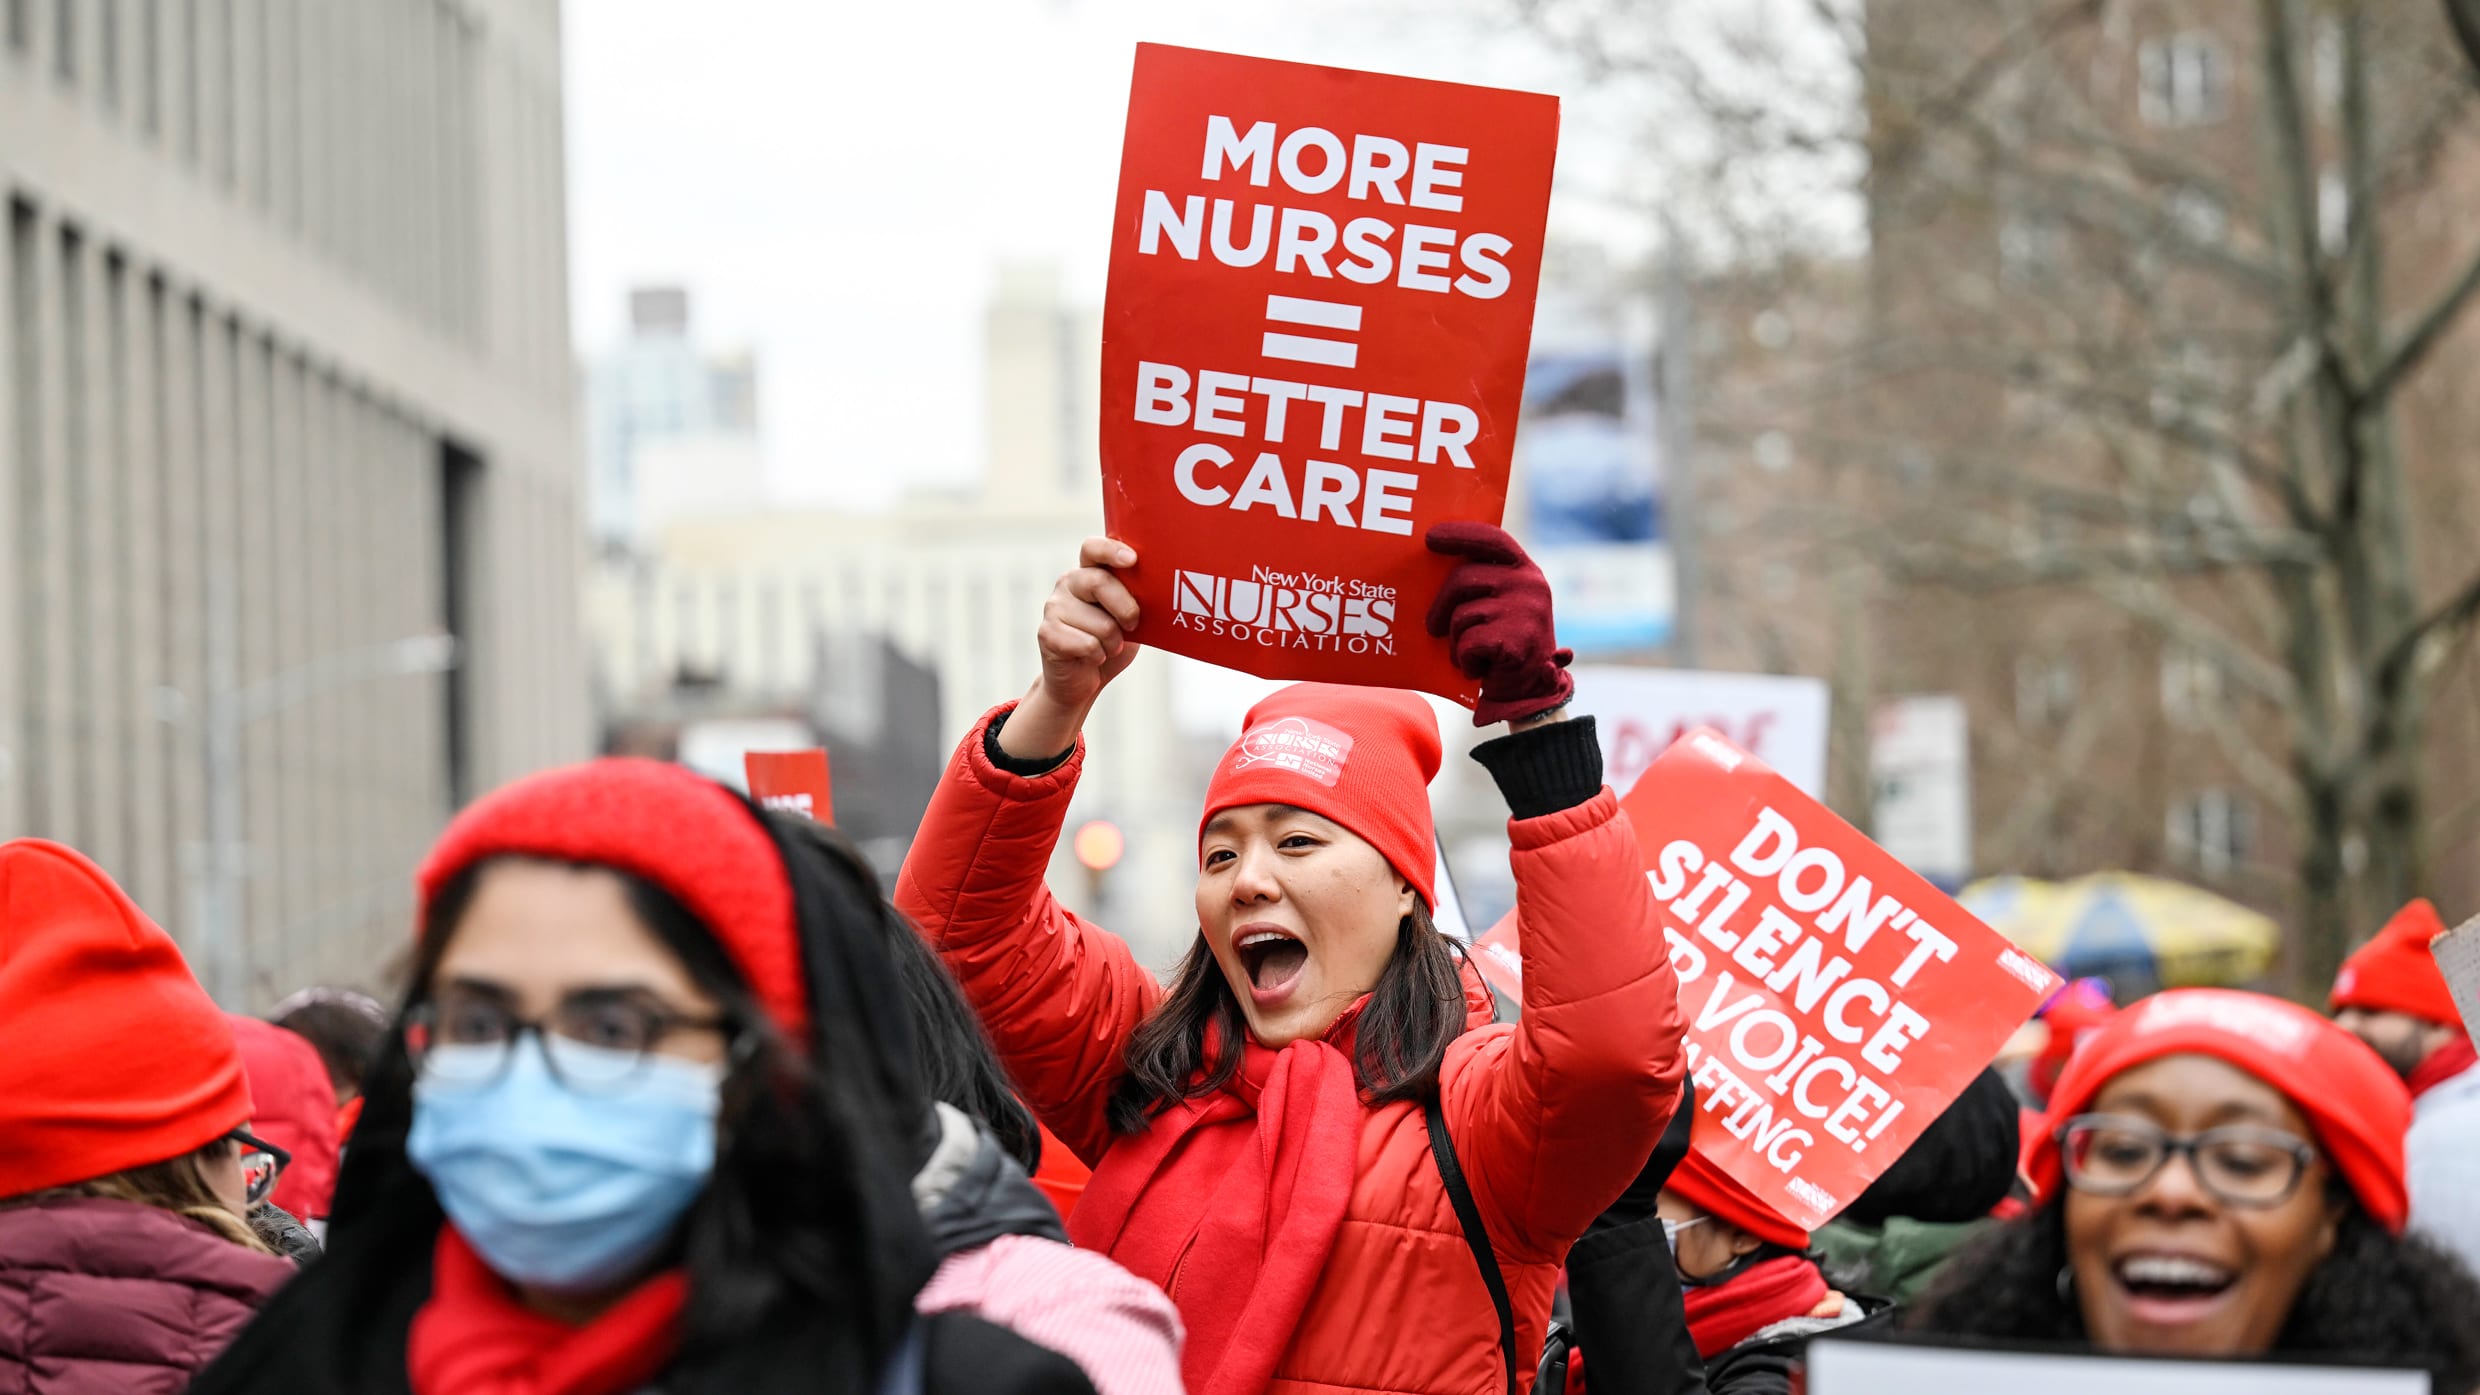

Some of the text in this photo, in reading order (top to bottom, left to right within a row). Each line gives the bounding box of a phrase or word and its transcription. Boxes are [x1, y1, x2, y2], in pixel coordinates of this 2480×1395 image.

[1201, 114, 1469, 213] MORE
[1138, 189, 1513, 299] NURSES
[1134, 360, 1479, 469] BETTER
[1173, 443, 1419, 536] CARE
[1173, 569, 1395, 640] NURSES
[1252, 564, 1397, 600] New York State
[1172, 611, 1394, 656] ASSOCIATION
[1253, 745, 1336, 767] ASSOCIATION
[1255, 733, 1340, 759] NURSES
[1730, 806, 1959, 988] DON'T
[1645, 840, 1931, 1075] SILENCE
[1694, 970, 1905, 1153] VOICE!
